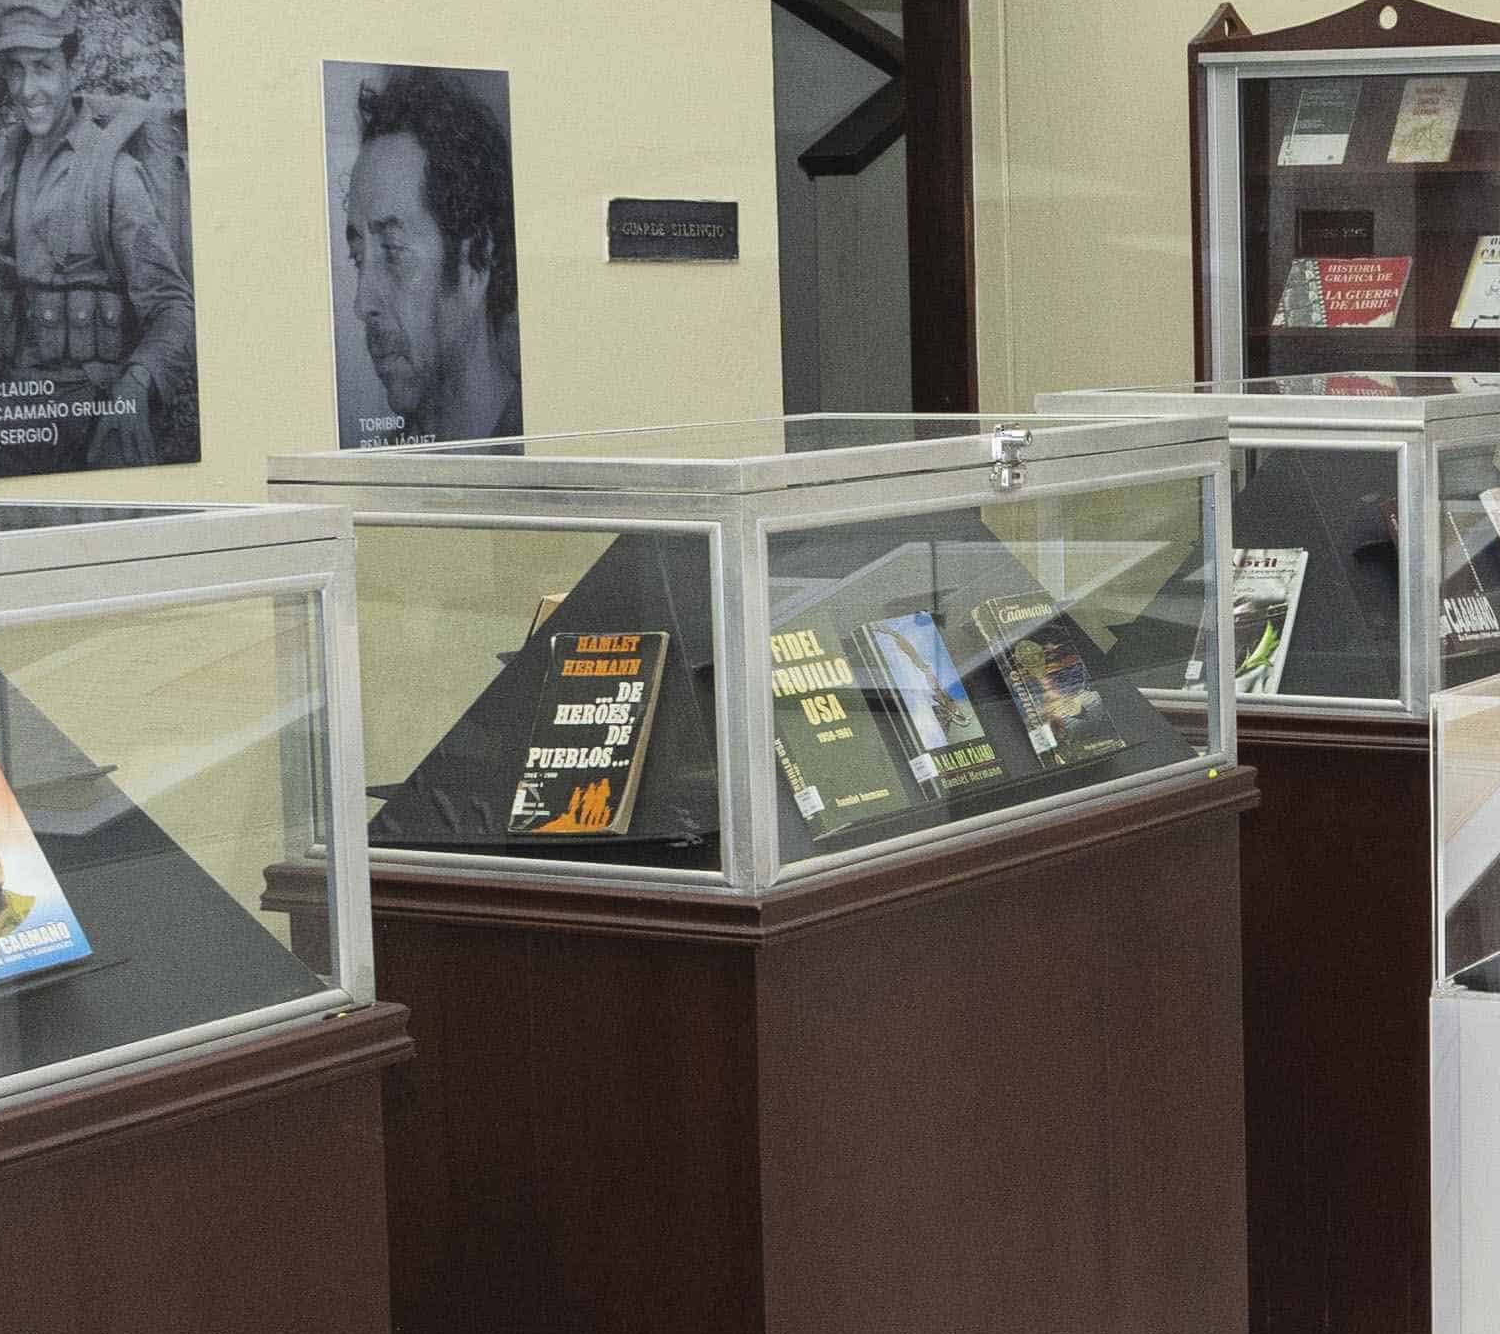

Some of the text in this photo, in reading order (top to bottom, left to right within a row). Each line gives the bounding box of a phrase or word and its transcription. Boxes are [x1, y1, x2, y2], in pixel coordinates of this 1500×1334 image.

[622, 221, 725, 238] GUARDE SILENCIO
[1328, 264, 1382, 273] HISTORIA
[1377, 272, 1393, 282] DE
[1326, 287, 1399, 301] LA GUERRA
[1330, 298, 1390, 310] DE ABRIL
[71, 395, 137, 416] GRULLÓN
[359, 415, 405, 433] TORIBIO
[576, 635, 641, 653] HAMLET
[771, 629, 825, 664] FIDEL
[562, 658, 643, 677] HERMANN
[800, 693, 847, 726] USA
[604, 725, 632, 746] DE
[526, 746, 630, 769] PUEBLOS...
[0, 921, 71, 954] CAAMAÑO
